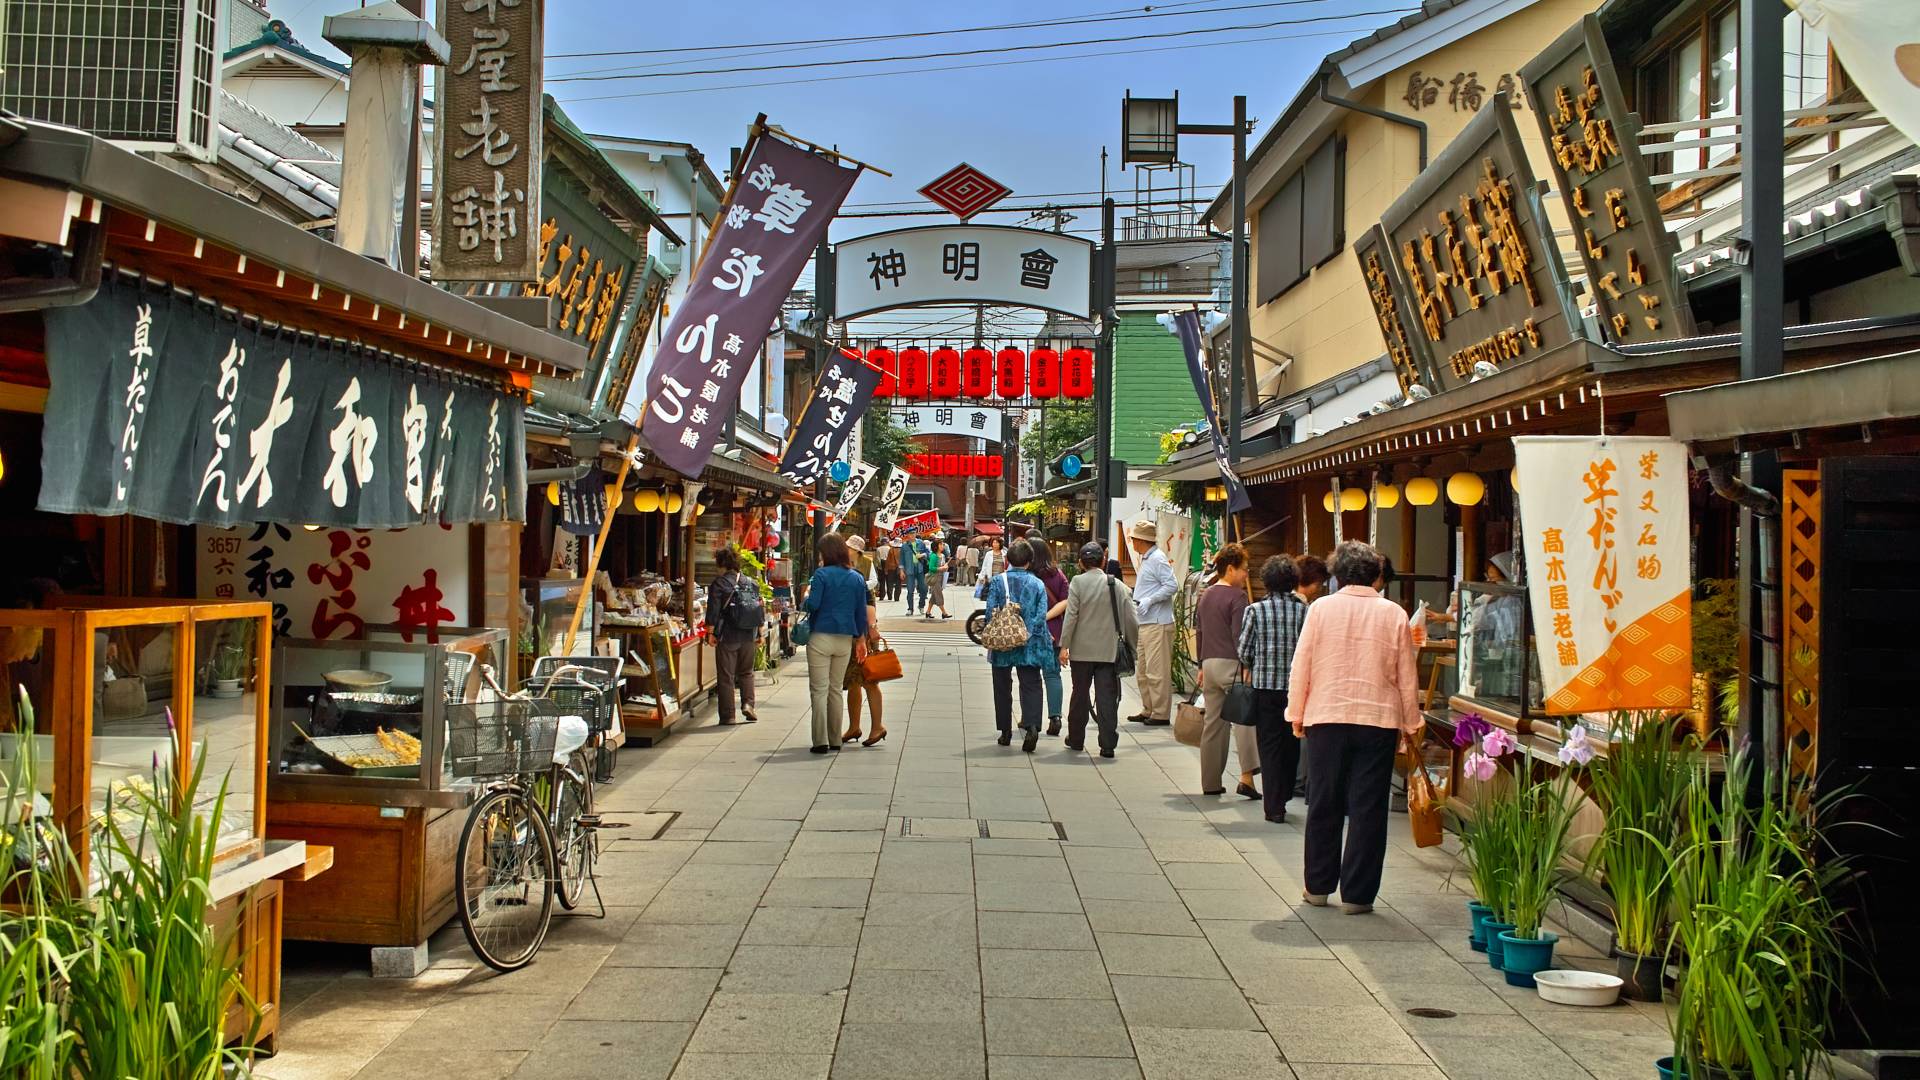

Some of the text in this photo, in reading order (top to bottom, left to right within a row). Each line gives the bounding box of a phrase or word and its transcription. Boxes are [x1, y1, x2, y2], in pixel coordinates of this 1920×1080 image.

[867, 242, 1059, 291] 神明會
[197, 337, 246, 512] おでん
[902, 408, 988, 430] 神明會
[207, 537, 242, 554] 3657
[307, 526, 372, 641] ぷら
[391, 514, 456, 644] 丼
[1582, 457, 1623, 634] 草だんご
